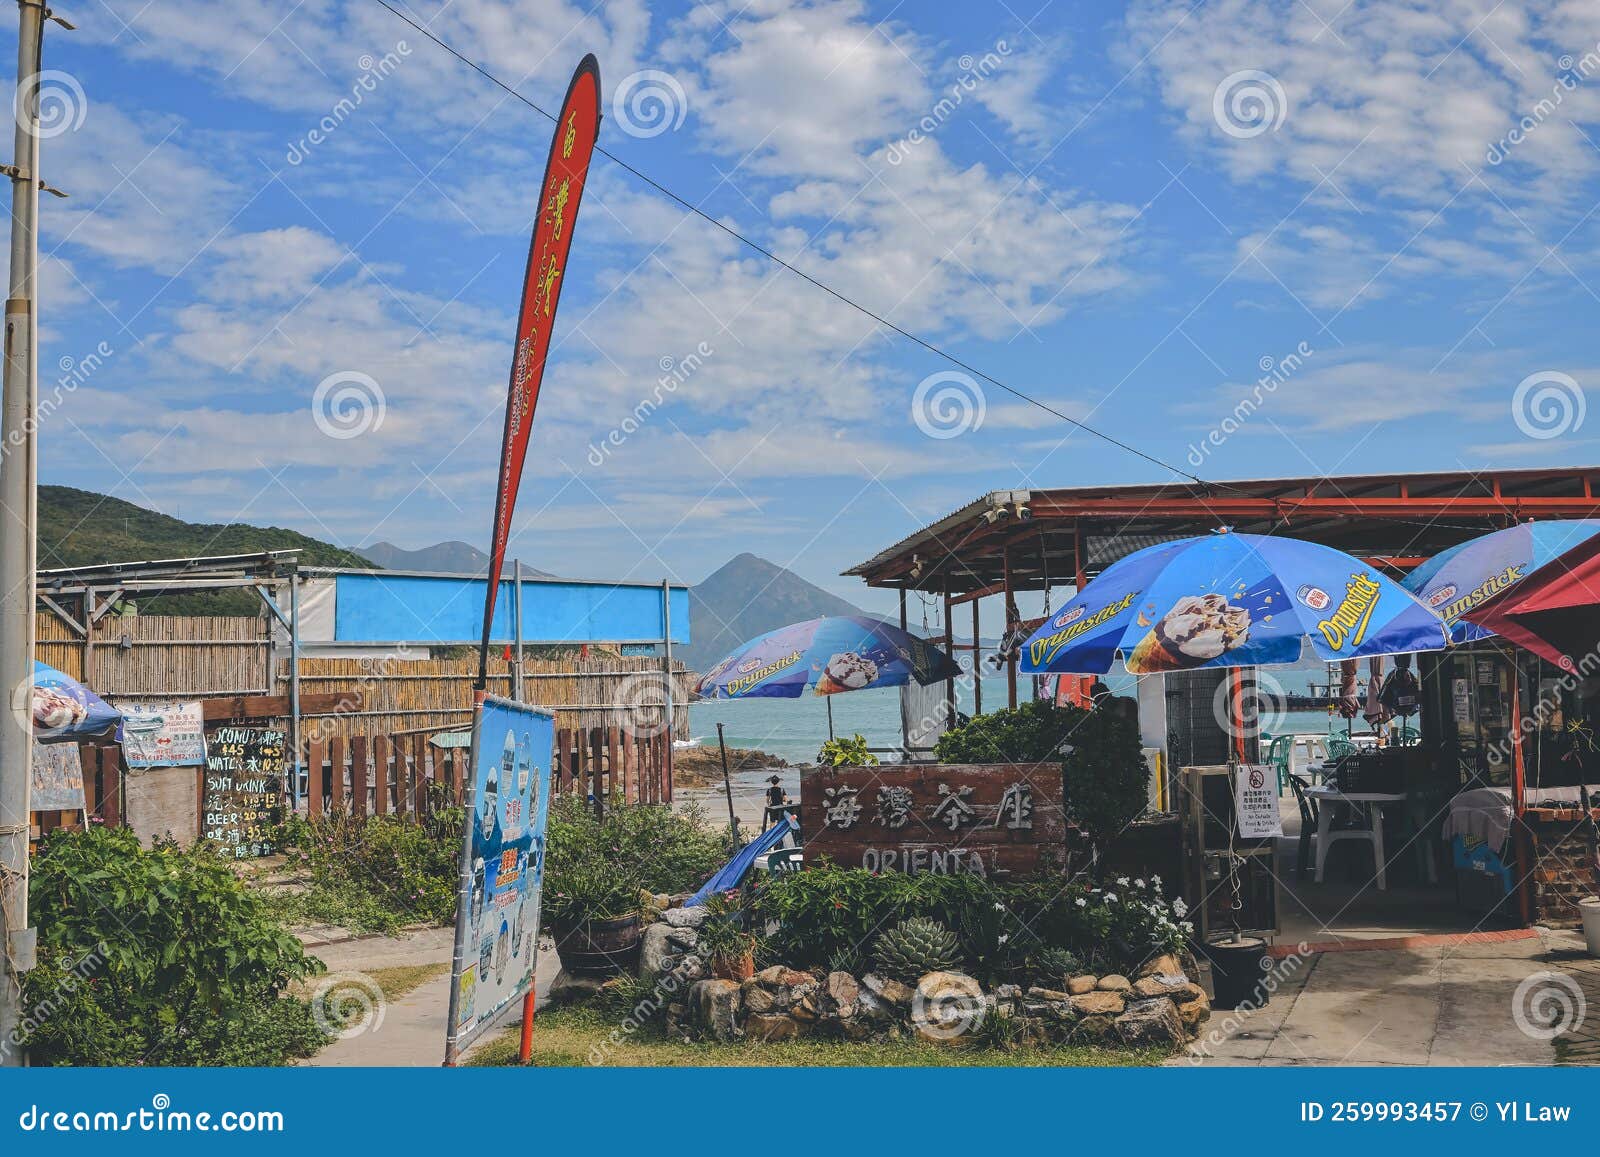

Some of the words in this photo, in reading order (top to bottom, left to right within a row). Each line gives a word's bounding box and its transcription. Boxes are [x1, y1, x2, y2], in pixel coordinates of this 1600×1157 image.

[1317, 573, 1380, 652] Drumstick
[1440, 564, 1524, 622] umstick
[1030, 591, 1137, 667] Drumstick
[727, 650, 802, 697] Drumstick
[207, 813, 239, 826] BEER
[822, 783, 1033, 831] 海灣茶座
